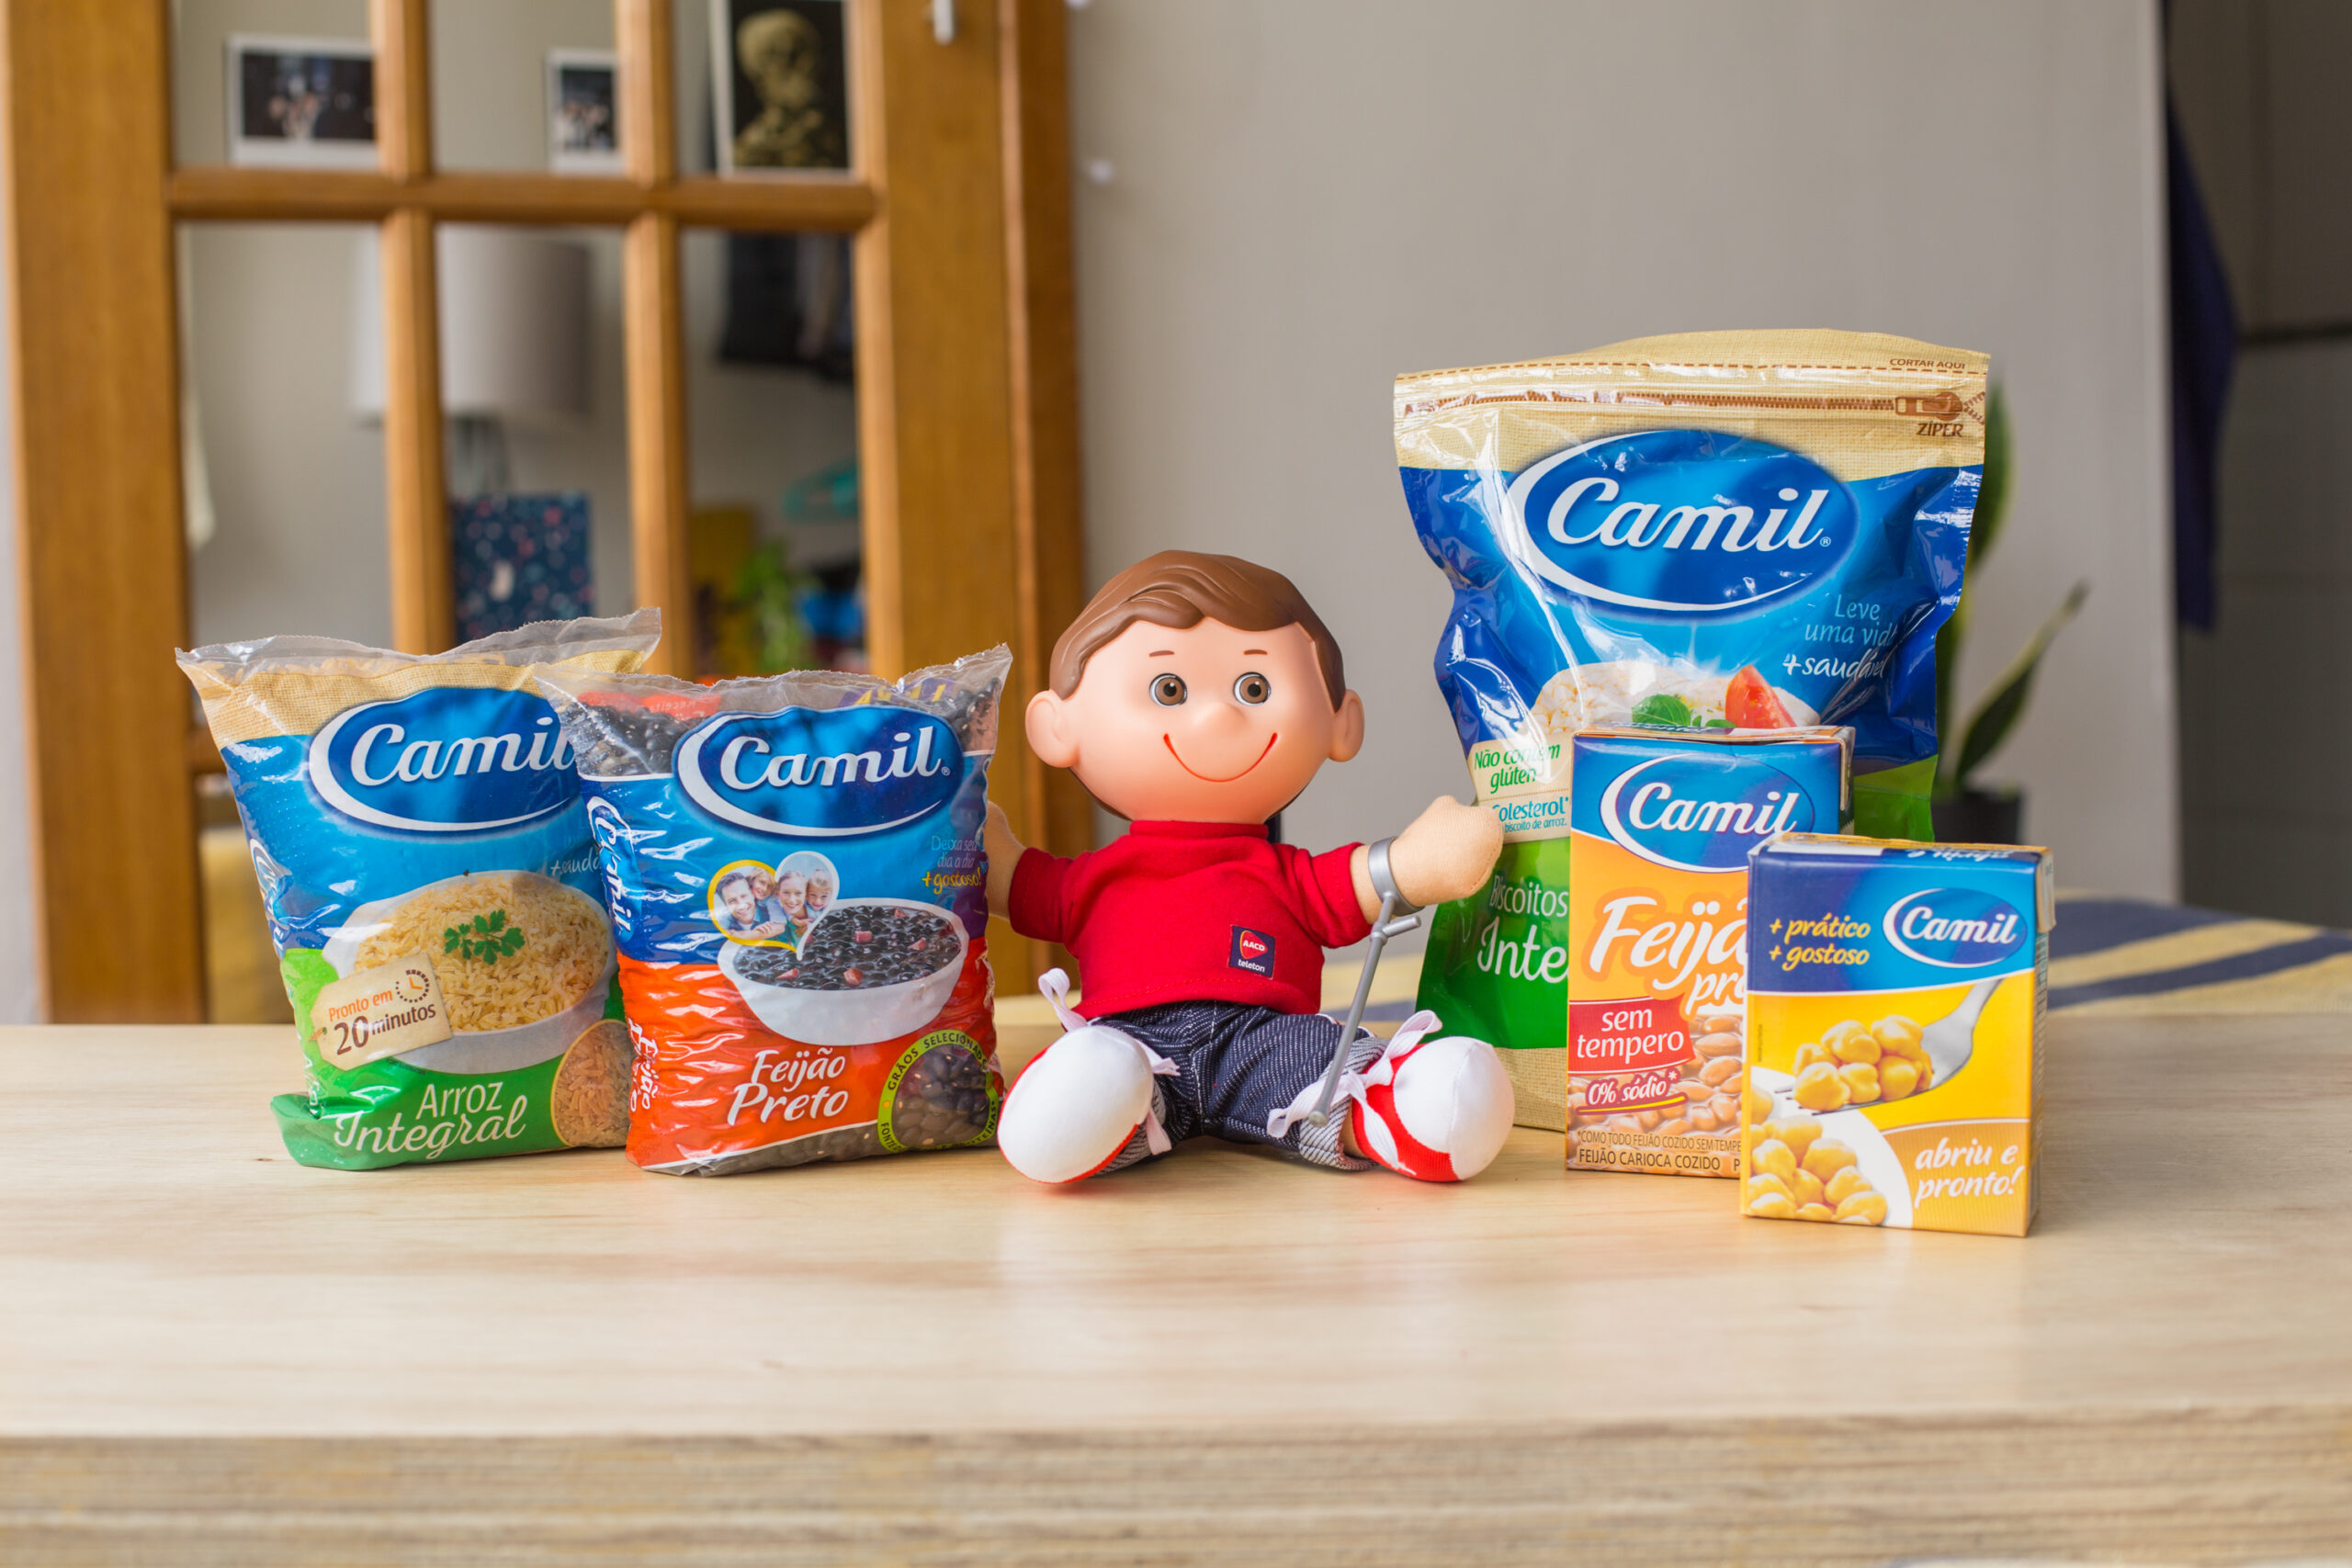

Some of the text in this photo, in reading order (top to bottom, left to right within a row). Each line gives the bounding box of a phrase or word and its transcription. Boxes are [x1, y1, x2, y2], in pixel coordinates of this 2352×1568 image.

[1889, 358, 1965, 369] CORTAR AQUI
[1916, 420, 1964, 438] ZÍPER
[1546, 477, 1830, 553] Camil
[1834, 593, 1881, 621] Leve
[1804, 624, 1856, 645] uma
[349, 716, 577, 788] Camil
[719, 725, 942, 792] Camil
[1474, 749, 1500, 771] Não
[1489, 766, 1537, 795] glúten
[1491, 795, 1569, 822] olesterol
[1532, 819, 1543, 829] de
[1628, 781, 1801, 836] Camil
[931, 835, 963, 852] Deixa
[937, 852, 954, 868] dia
[955, 857, 961, 868] a
[1488, 874, 1569, 918] Biscoitos
[1783, 911, 1871, 944] prático
[1901, 905, 2020, 945] Camil
[1242, 940, 1266, 952] AACD
[1476, 915, 1569, 984] Inte
[1589, 896, 1747, 991] Feijã
[1781, 942, 1871, 972] gostoso
[1238, 958, 1266, 973] teleton
[328, 989, 393, 1022] Pronto em
[1600, 1008, 1653, 1032] sem
[334, 1003, 437, 1056] 20 minutos
[1576, 1030, 1684, 1066] tempero
[751, 1047, 846, 1093] Feijão
[887, 1047, 919, 1091] GRÃOS
[415, 1081, 504, 1121] Arroz
[727, 1082, 849, 1126] Preto
[1588, 1080, 1617, 1106] 0%
[333, 1094, 528, 1160] Integral
[1608, 1132, 1632, 1146] TODO
[1633, 1134, 1661, 1148] FEIJÃO
[1661, 1136, 1695, 1150] COZIDO
[1696, 1138, 1714, 1151] SEM
[1714, 1139, 1742, 1153] TEMPE
[1578, 1146, 1617, 1166] FEIJÃO
[1619, 1151, 1672, 1168] CARIOCA
[1674, 1155, 1721, 1171] COZIDO
[1914, 1136, 2019, 1171] abriu e
[1913, 1164, 2026, 1210] pronto!
